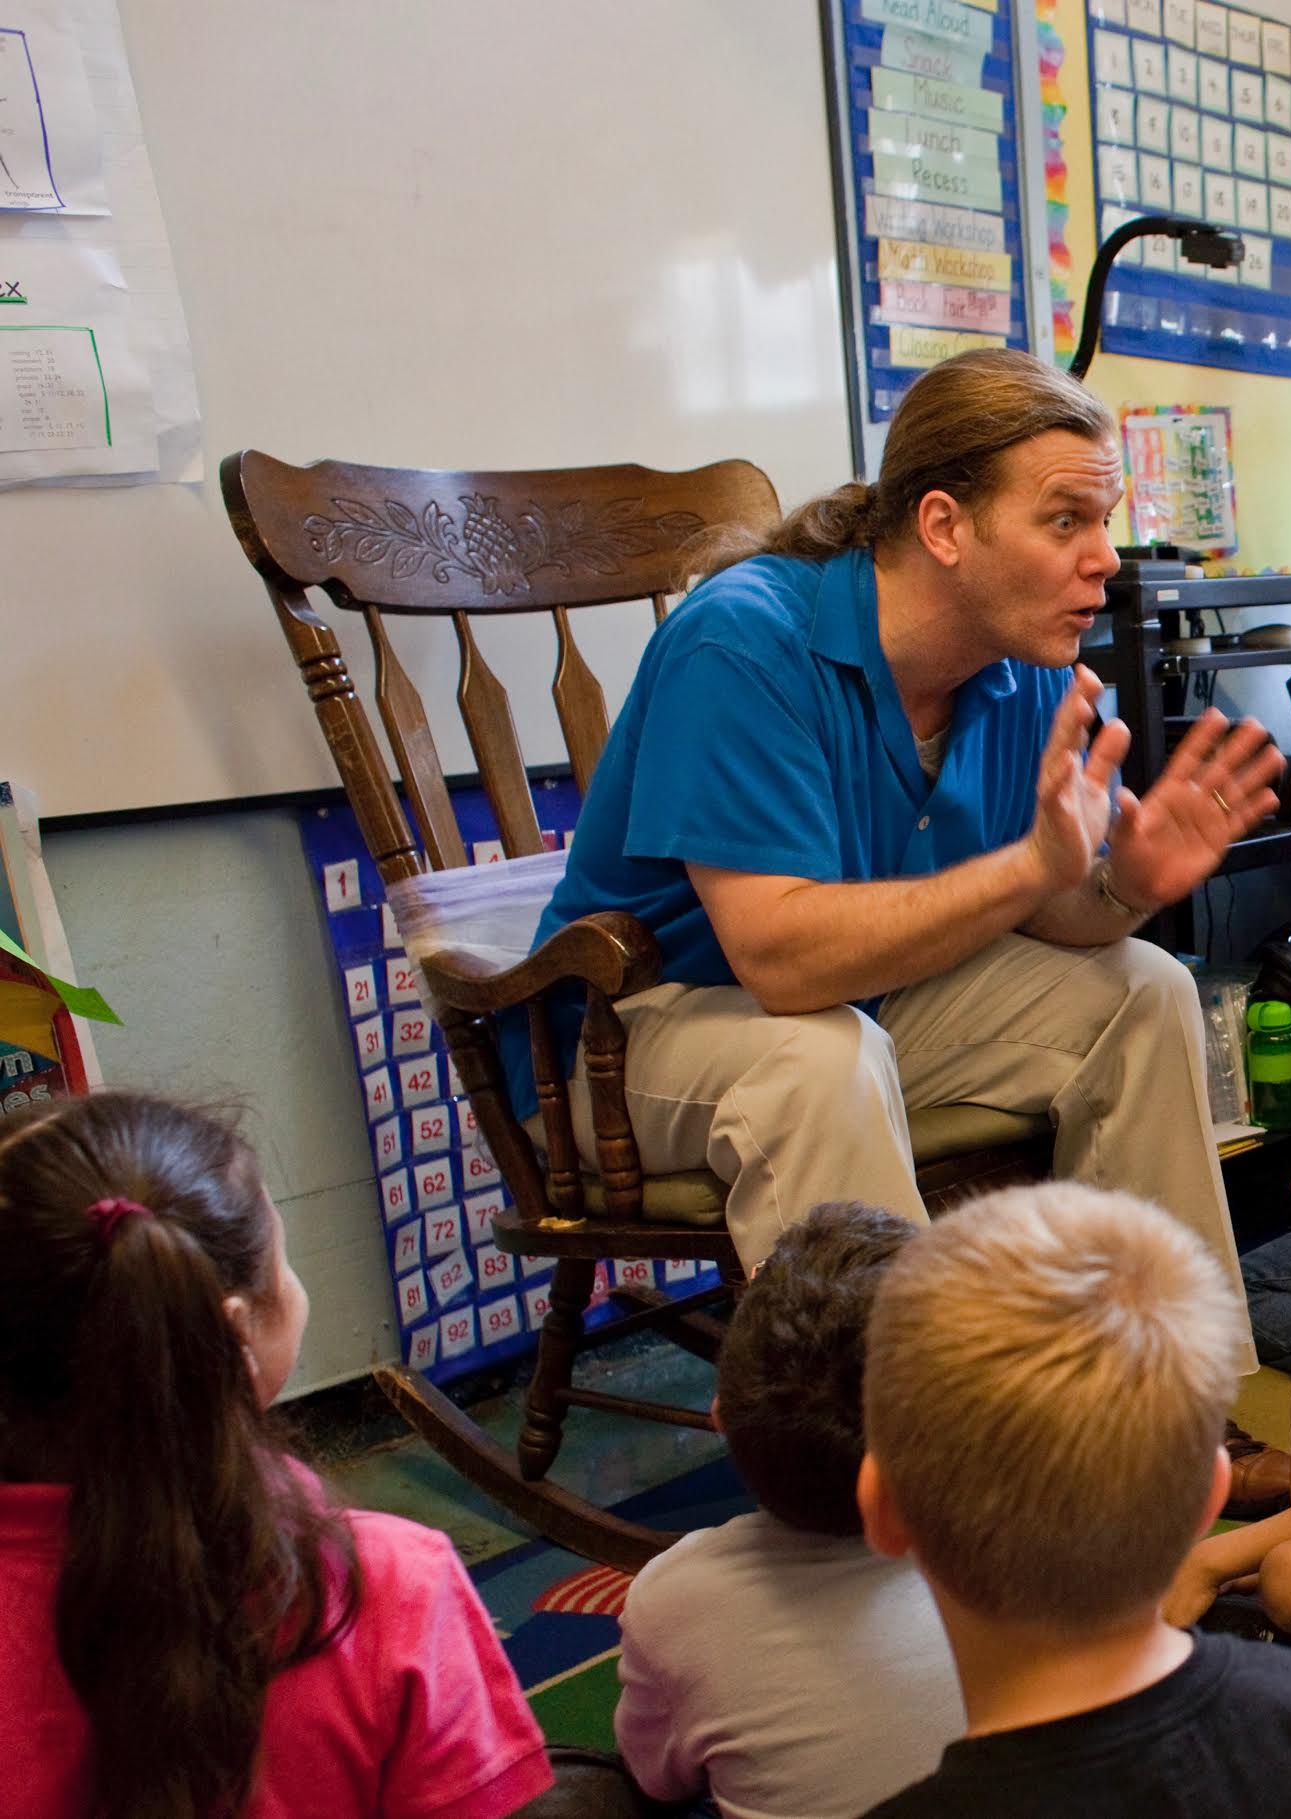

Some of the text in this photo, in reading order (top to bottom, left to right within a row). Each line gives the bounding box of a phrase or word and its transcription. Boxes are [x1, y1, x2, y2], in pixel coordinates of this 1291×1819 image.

[926, 0, 970, 36] Aloud
[902, 34, 952, 79] Snack
[913, 75, 967, 113] Music
[905, 115, 963, 153] Lunch
[911, 157, 969, 195] Recess
[338, 871, 347, 897] 1
[354, 980, 369, 1002] 21
[366, 1021, 425, 1053] 31 32
[373, 1070, 432, 1104] 41 42
[383, 1112, 477, 1155] 51 52 5
[389, 1184, 403, 1207] 61
[423, 1172, 446, 1196] 62
[402, 1236, 415, 1257] 71
[432, 1220, 455, 1242] 72
[407, 1254, 508, 1308] 81 82 83
[417, 1338, 432, 1358] 91
[448, 1319, 468, 1342] 92
[489, 1308, 513, 1331] 93
[534, 1298, 552, 1316] 9
[622, 1263, 648, 1281] 96
